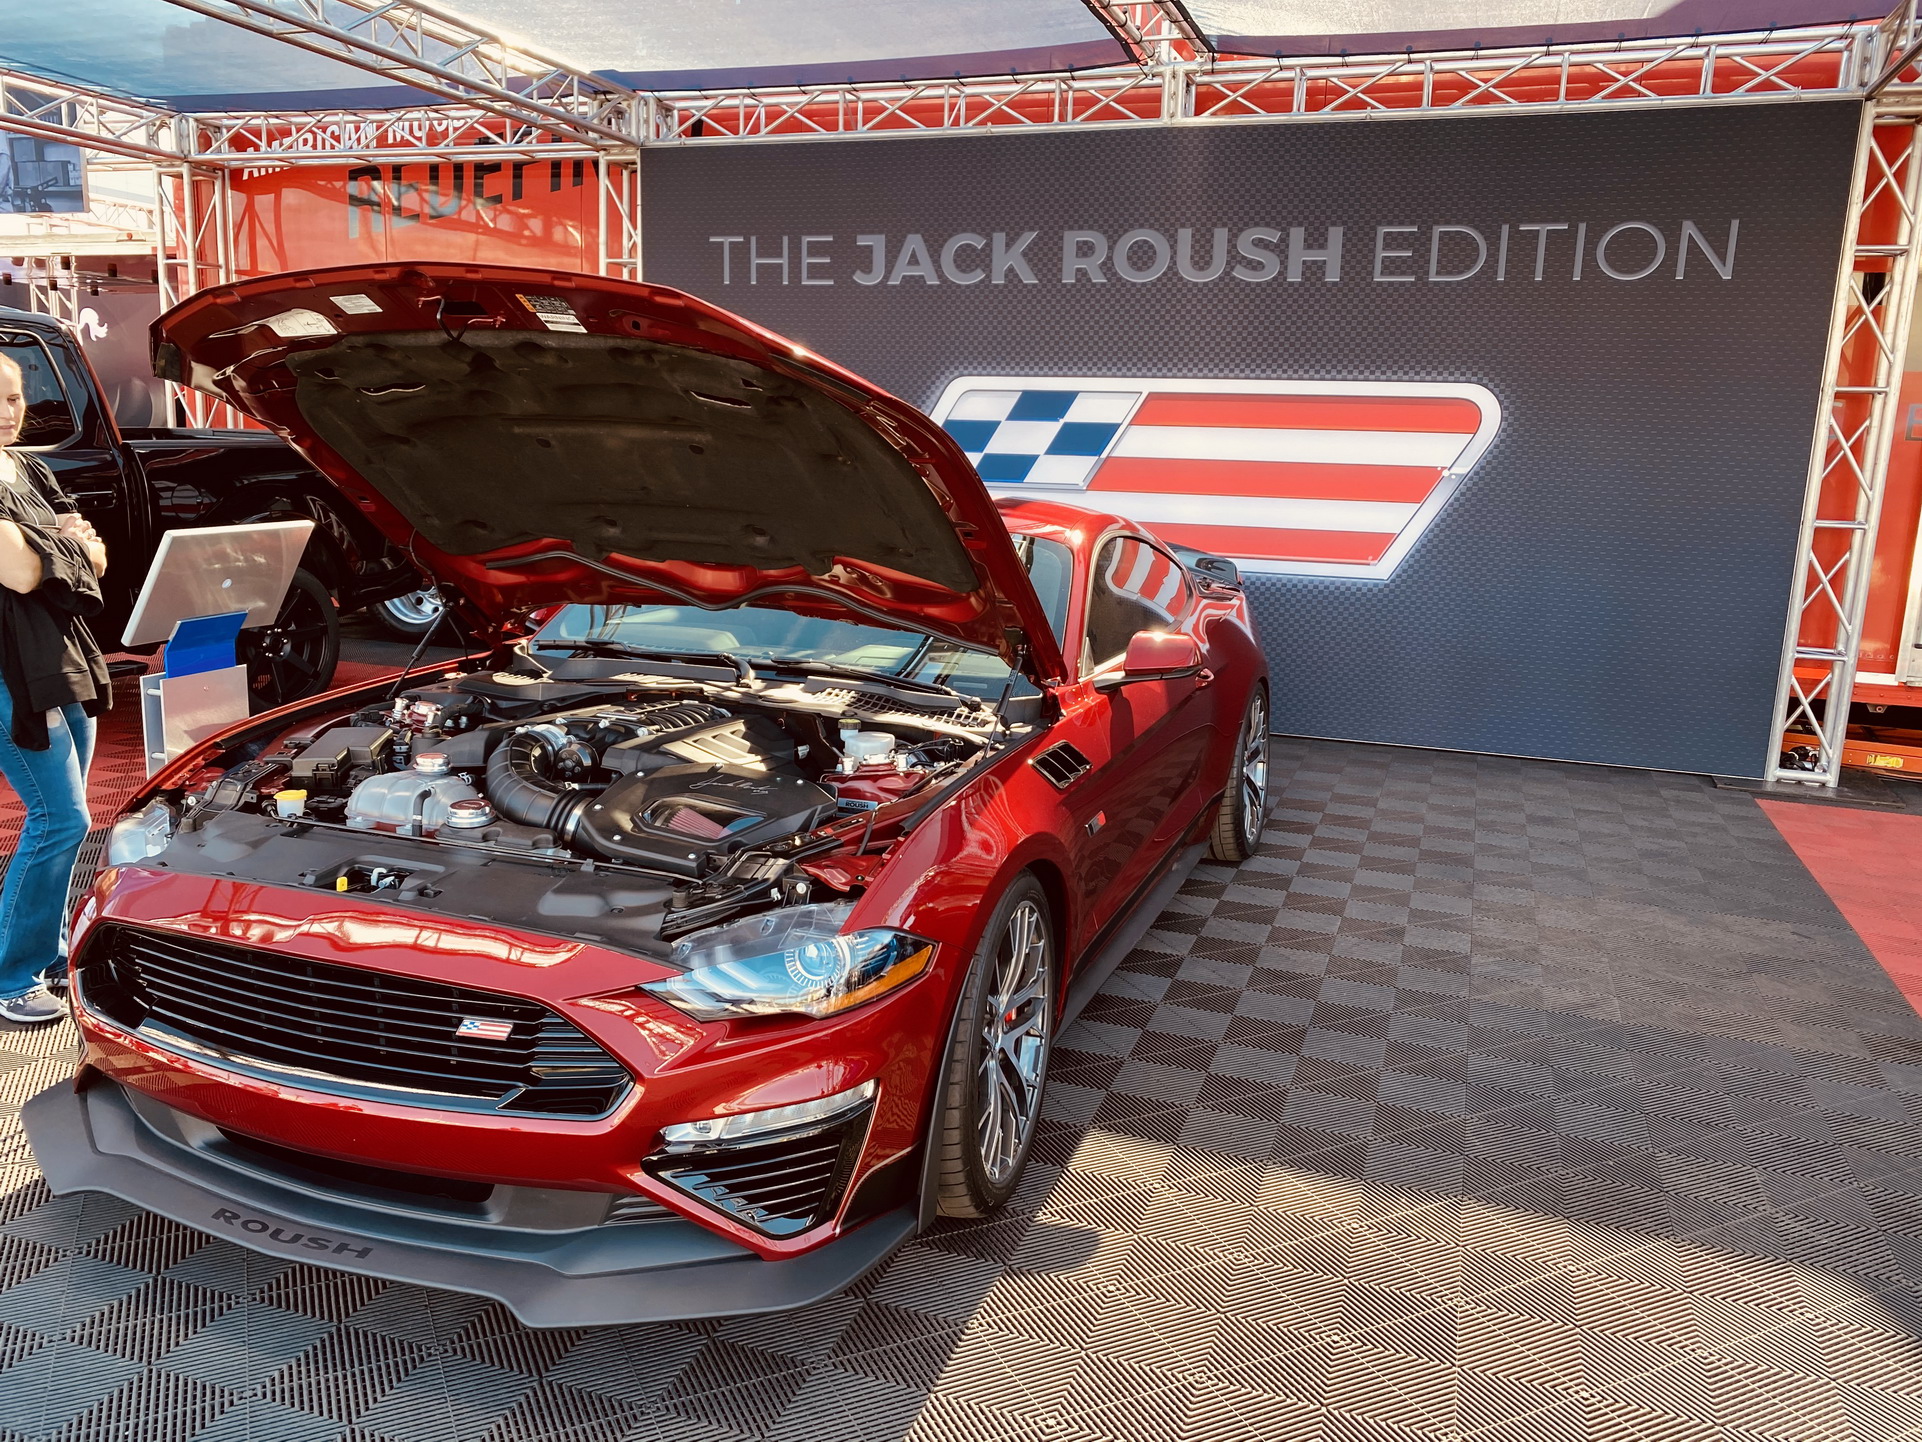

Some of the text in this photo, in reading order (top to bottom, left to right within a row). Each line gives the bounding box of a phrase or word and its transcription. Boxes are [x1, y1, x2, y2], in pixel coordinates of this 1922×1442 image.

[708, 218, 1741, 286] THE JACK ROUSH EDITION
[845, 800, 869, 809] ROUSH
[210, 1207, 374, 1259] ROUSH
